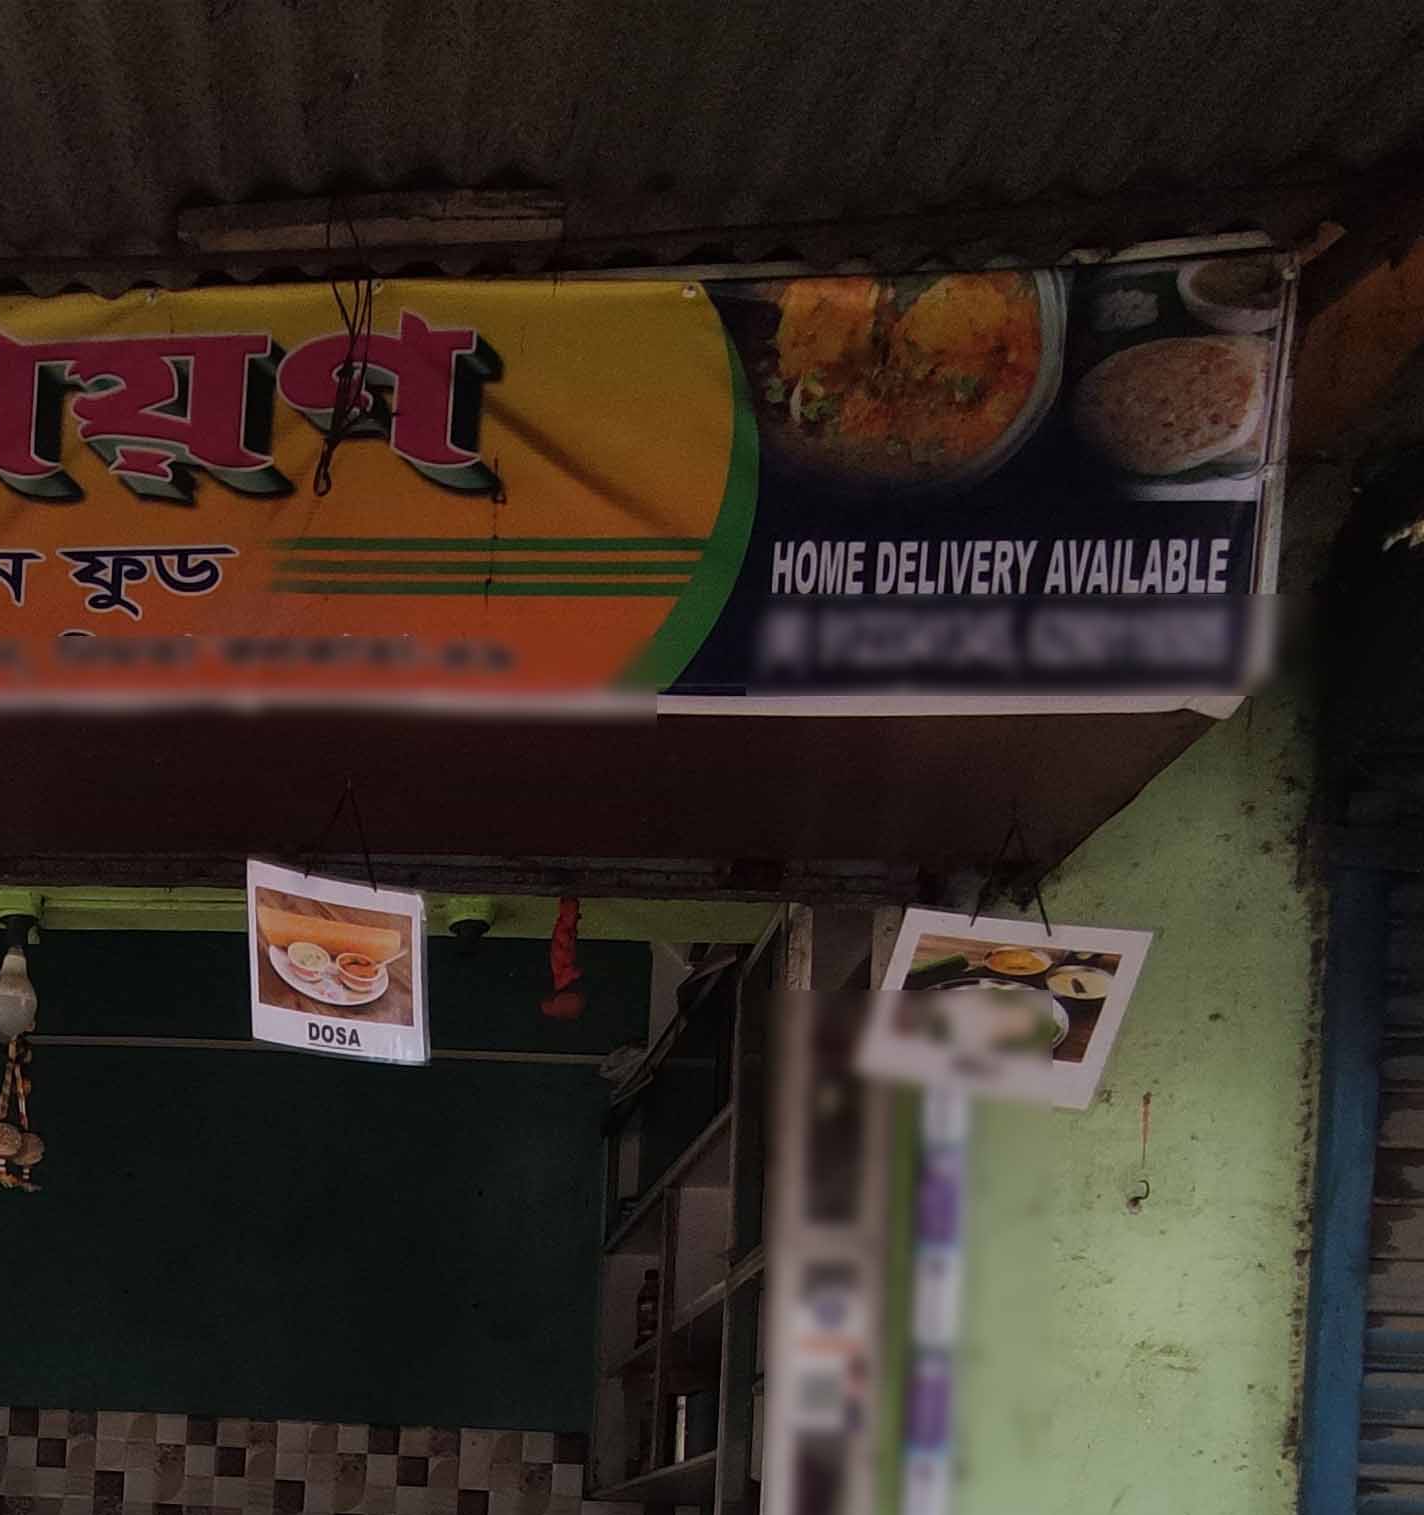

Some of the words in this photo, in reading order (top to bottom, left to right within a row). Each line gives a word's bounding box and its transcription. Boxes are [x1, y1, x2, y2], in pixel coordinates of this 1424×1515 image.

[56, 544, 240, 619] ফুড
[771, 540, 866, 594] HOME
[875, 539, 1039, 594] DELIVERY
[1043, 538, 1231, 594] AVAILABLE
[308, 1022, 360, 1046] DOSA
